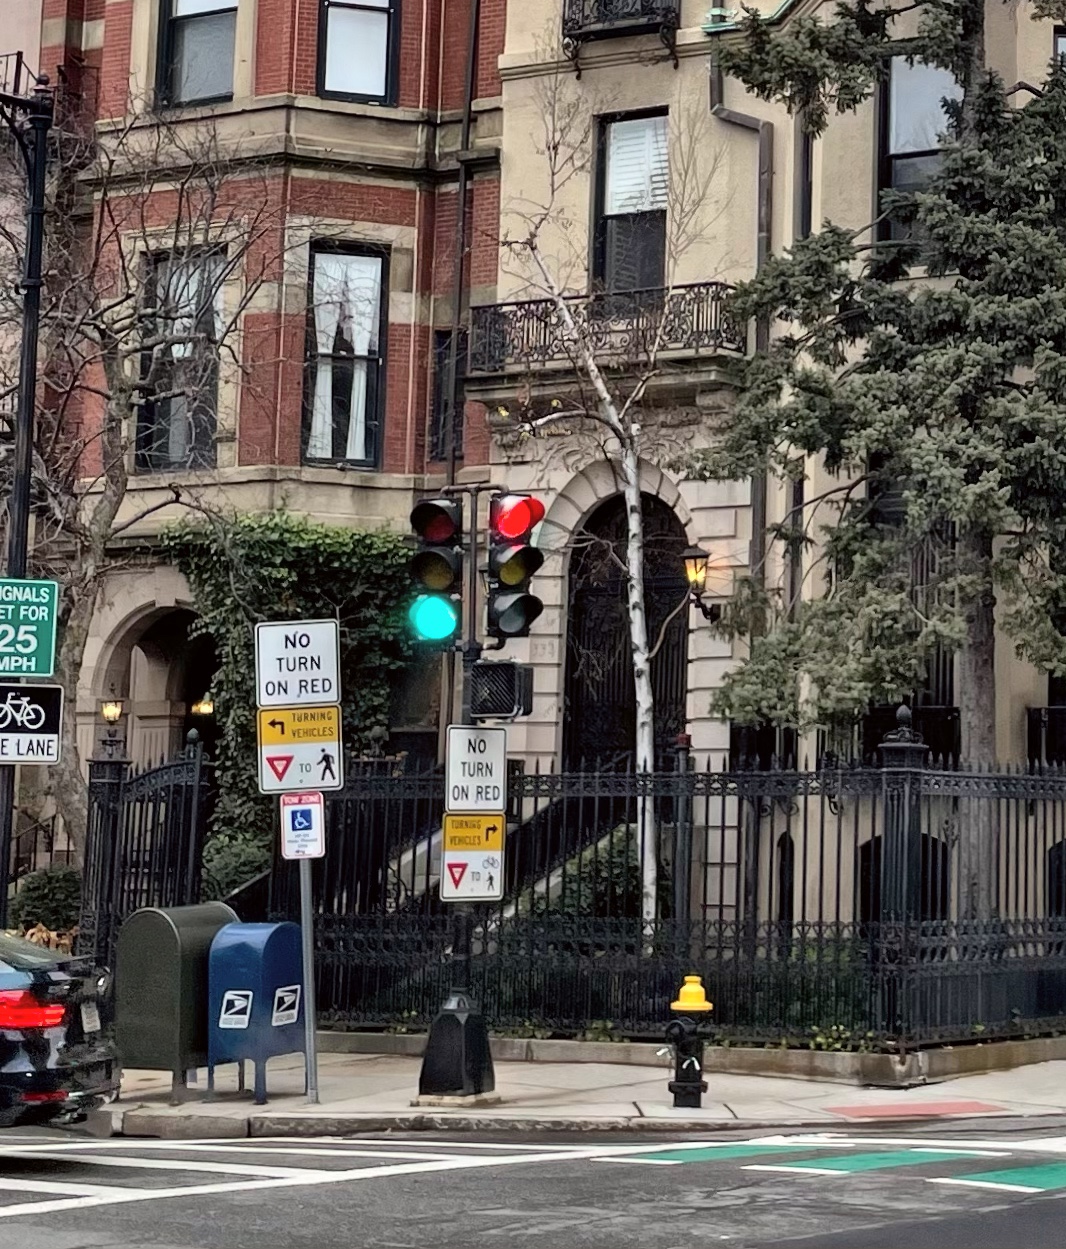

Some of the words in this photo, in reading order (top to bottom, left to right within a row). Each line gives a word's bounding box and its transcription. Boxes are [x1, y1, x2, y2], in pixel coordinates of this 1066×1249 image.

[0, 586, 50, 603] IGNALS
[0, 605, 15, 619] ET
[20, 605, 49, 621] FOR
[0, 623, 38, 653] 25
[284, 633, 311, 649] NO
[0, 656, 36, 671] MPH
[276, 655, 321, 672] TURN
[265, 680, 288, 696] ON
[299, 678, 332, 694] RED
[292, 711, 333, 722] TURNING
[291, 726, 334, 738] VEHICLES
[17, 738, 55, 756] LANE
[468, 738, 487, 754] NO
[299, 763, 312, 773] TO
[461, 761, 493, 777] TURN
[452, 785, 469, 801] ON
[476, 785, 501, 801] RED
[471, 871, 481, 881] TO
